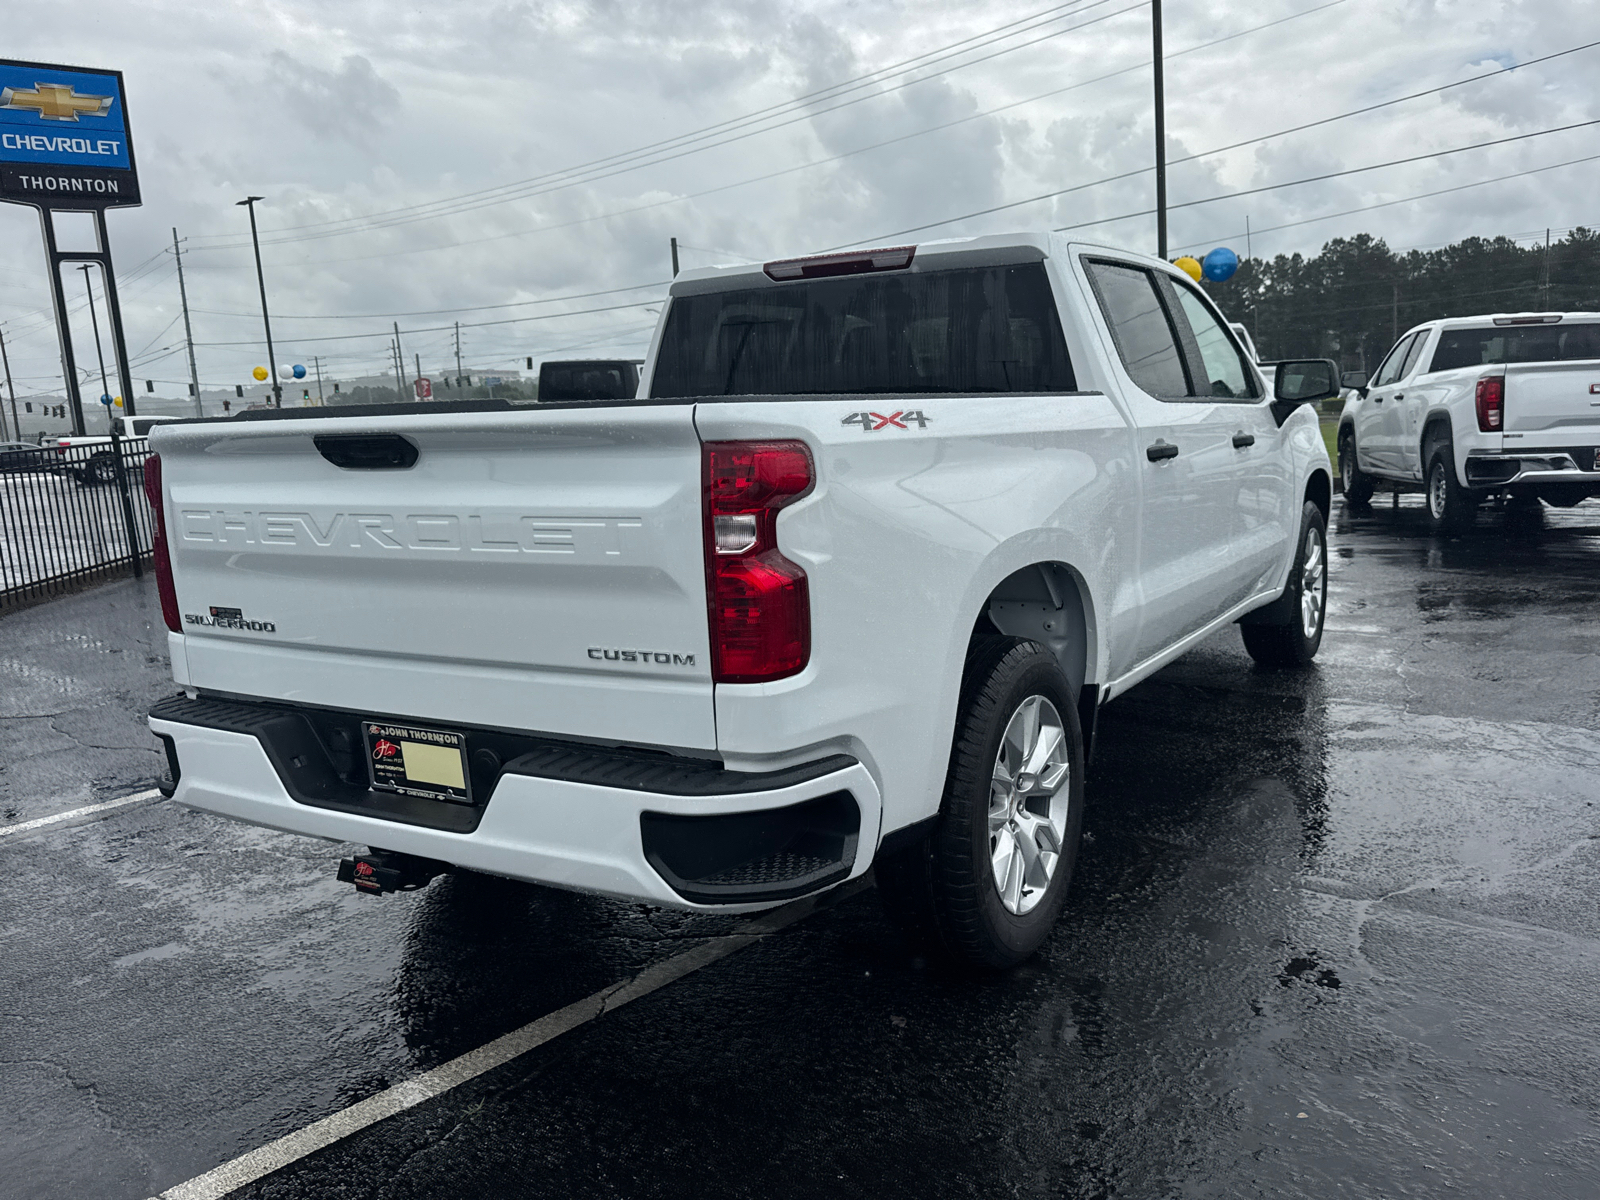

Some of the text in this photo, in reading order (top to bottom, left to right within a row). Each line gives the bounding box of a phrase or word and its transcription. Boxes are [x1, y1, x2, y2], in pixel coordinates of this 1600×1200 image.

[2, 132, 120, 156] CHEVROLET
[19, 175, 119, 193] THORNTON
[181, 509, 643, 555] CHEVROLET
[185, 614, 276, 633] SILVERADO
[587, 648, 696, 666] CUSTOM
[384, 726, 409, 738] JOHN
[409, 730, 459, 745] THORNTON
[406, 789, 436, 799] CHEVROLET
